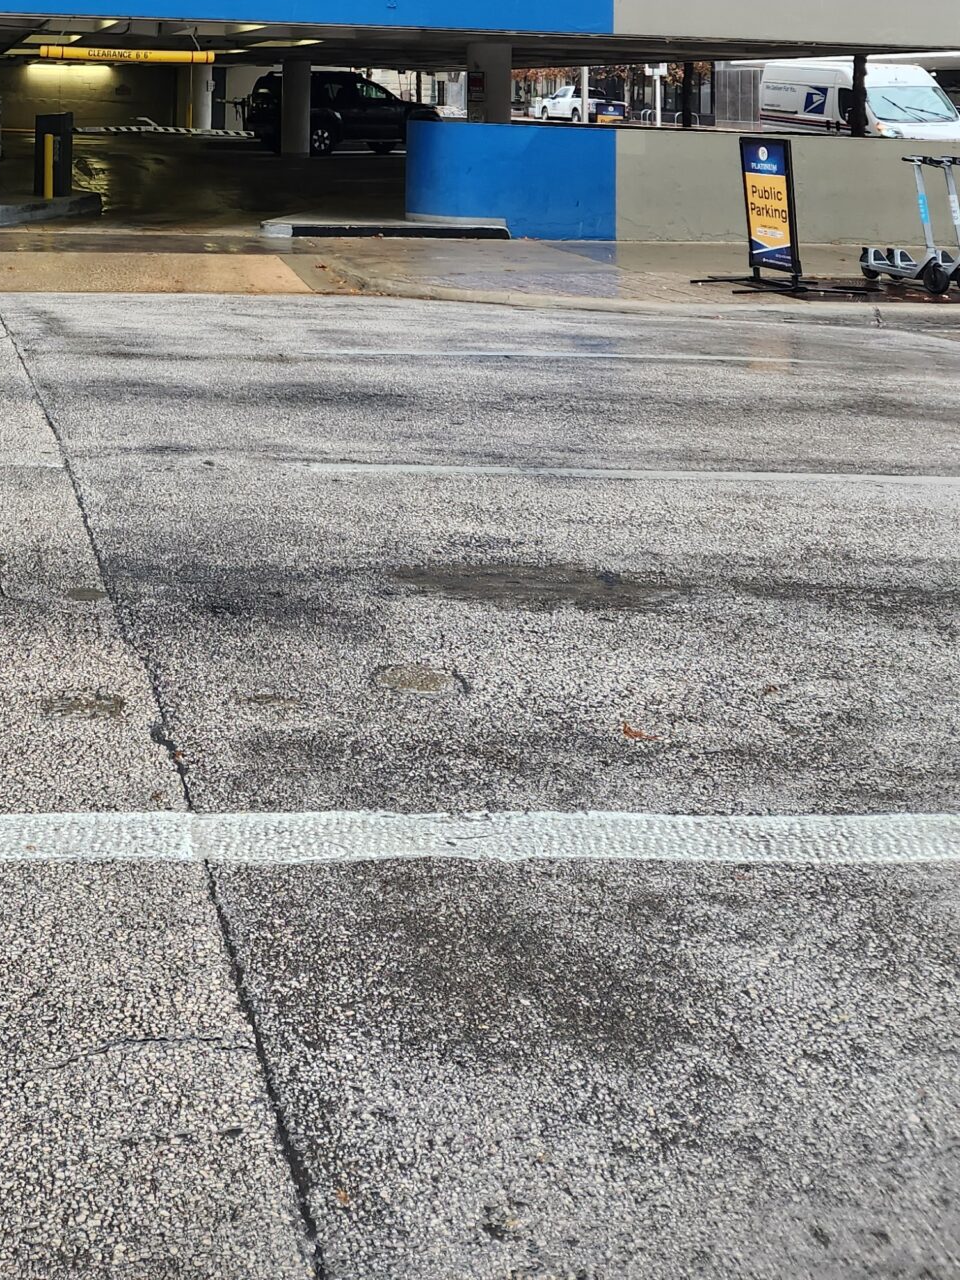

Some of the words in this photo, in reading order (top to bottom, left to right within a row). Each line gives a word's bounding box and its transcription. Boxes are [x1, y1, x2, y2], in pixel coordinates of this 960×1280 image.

[88, 50, 132, 58] CLEARANCE
[751, 162, 778, 171] PLATINUM
[751, 185, 783, 202] Public
[750, 202, 788, 223] Parking
